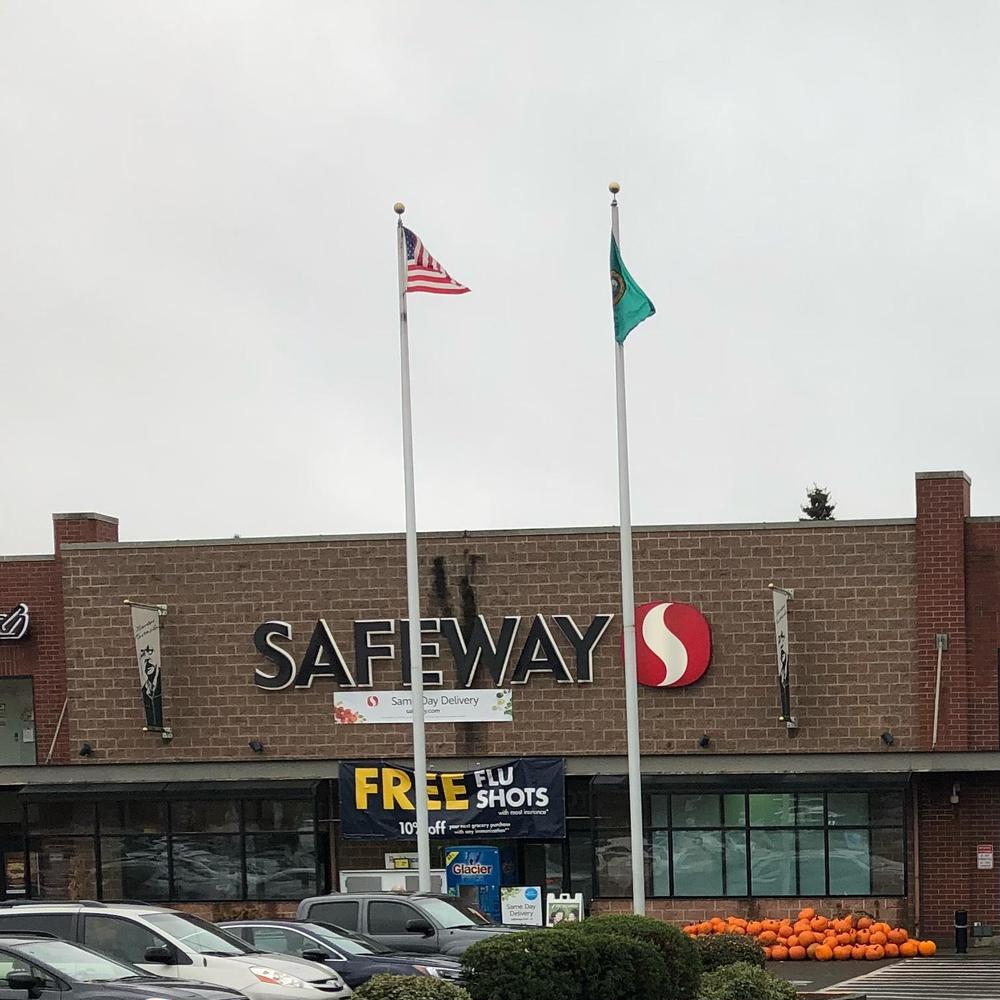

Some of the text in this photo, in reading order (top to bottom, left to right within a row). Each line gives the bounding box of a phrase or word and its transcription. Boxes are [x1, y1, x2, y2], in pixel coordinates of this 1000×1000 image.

[253, 613, 615, 690] SAFEWAY
[391, 696, 413, 706] Sam
[441, 695, 479, 706] Delivery
[474, 766, 514, 788] FLU
[354, 767, 469, 810] FREE
[476, 787, 549, 809] SHOTS
[428, 820, 446, 835] off
[453, 863, 493, 875] Glacier
